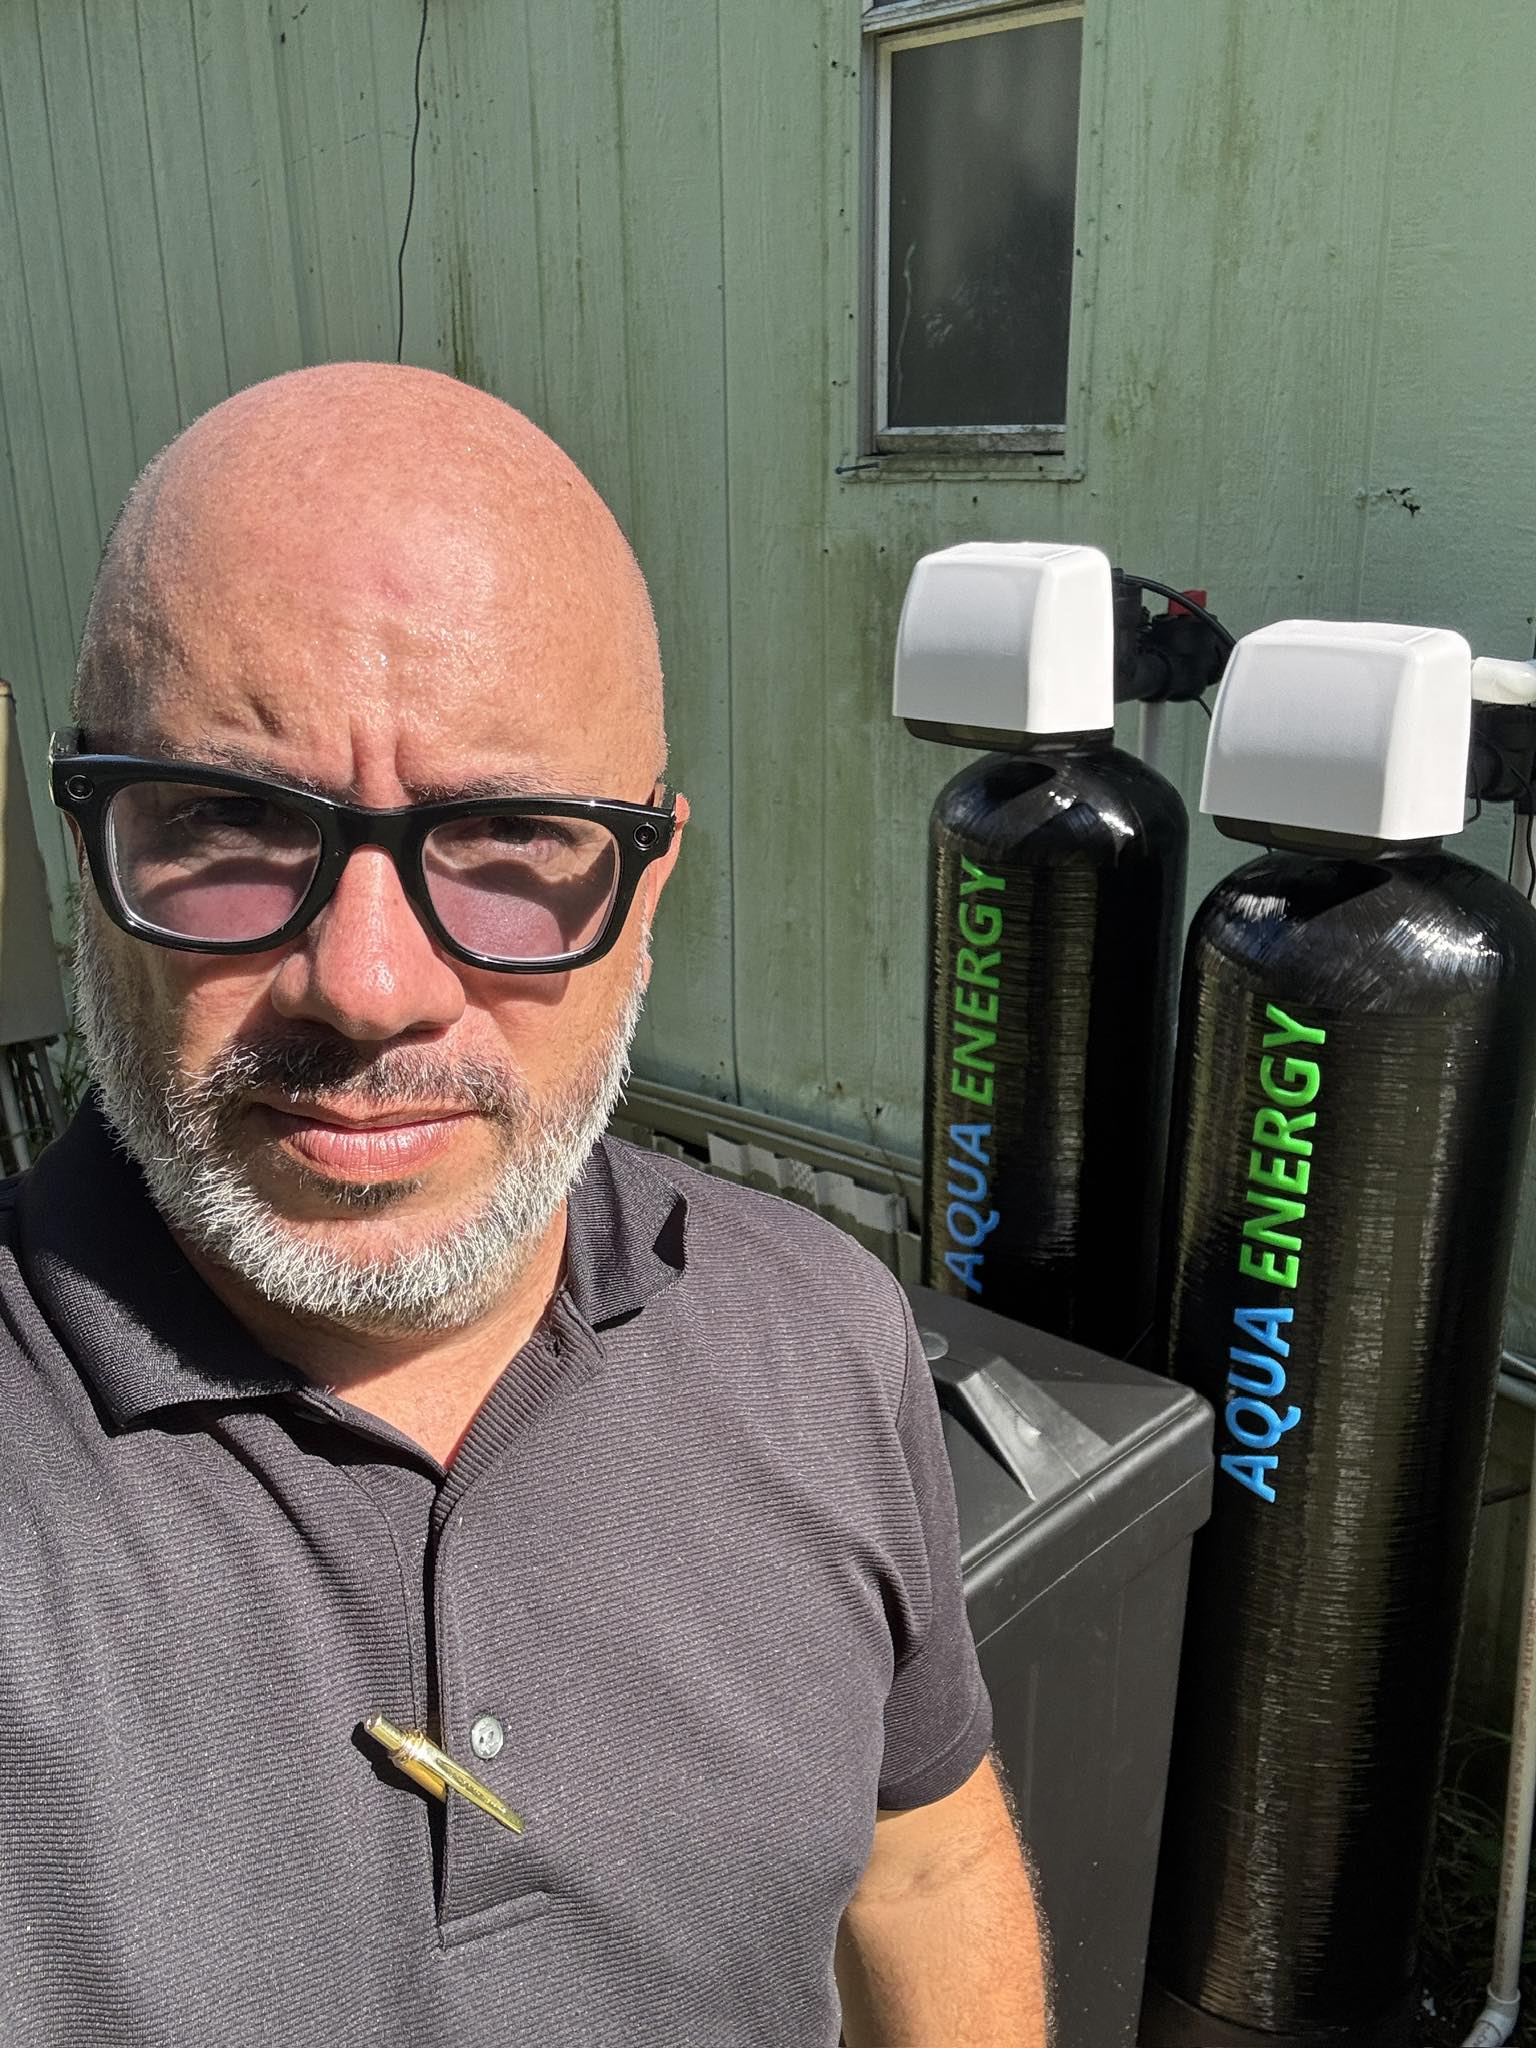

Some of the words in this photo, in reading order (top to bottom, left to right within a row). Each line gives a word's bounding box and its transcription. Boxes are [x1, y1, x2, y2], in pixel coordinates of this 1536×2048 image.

[951, 858, 1006, 1106] ENERGY
[946, 1123, 1000, 1293] AQUA
[1239, 1004, 1326, 1288] ENERGY
[1220, 1307, 1301, 1503] AQUA
